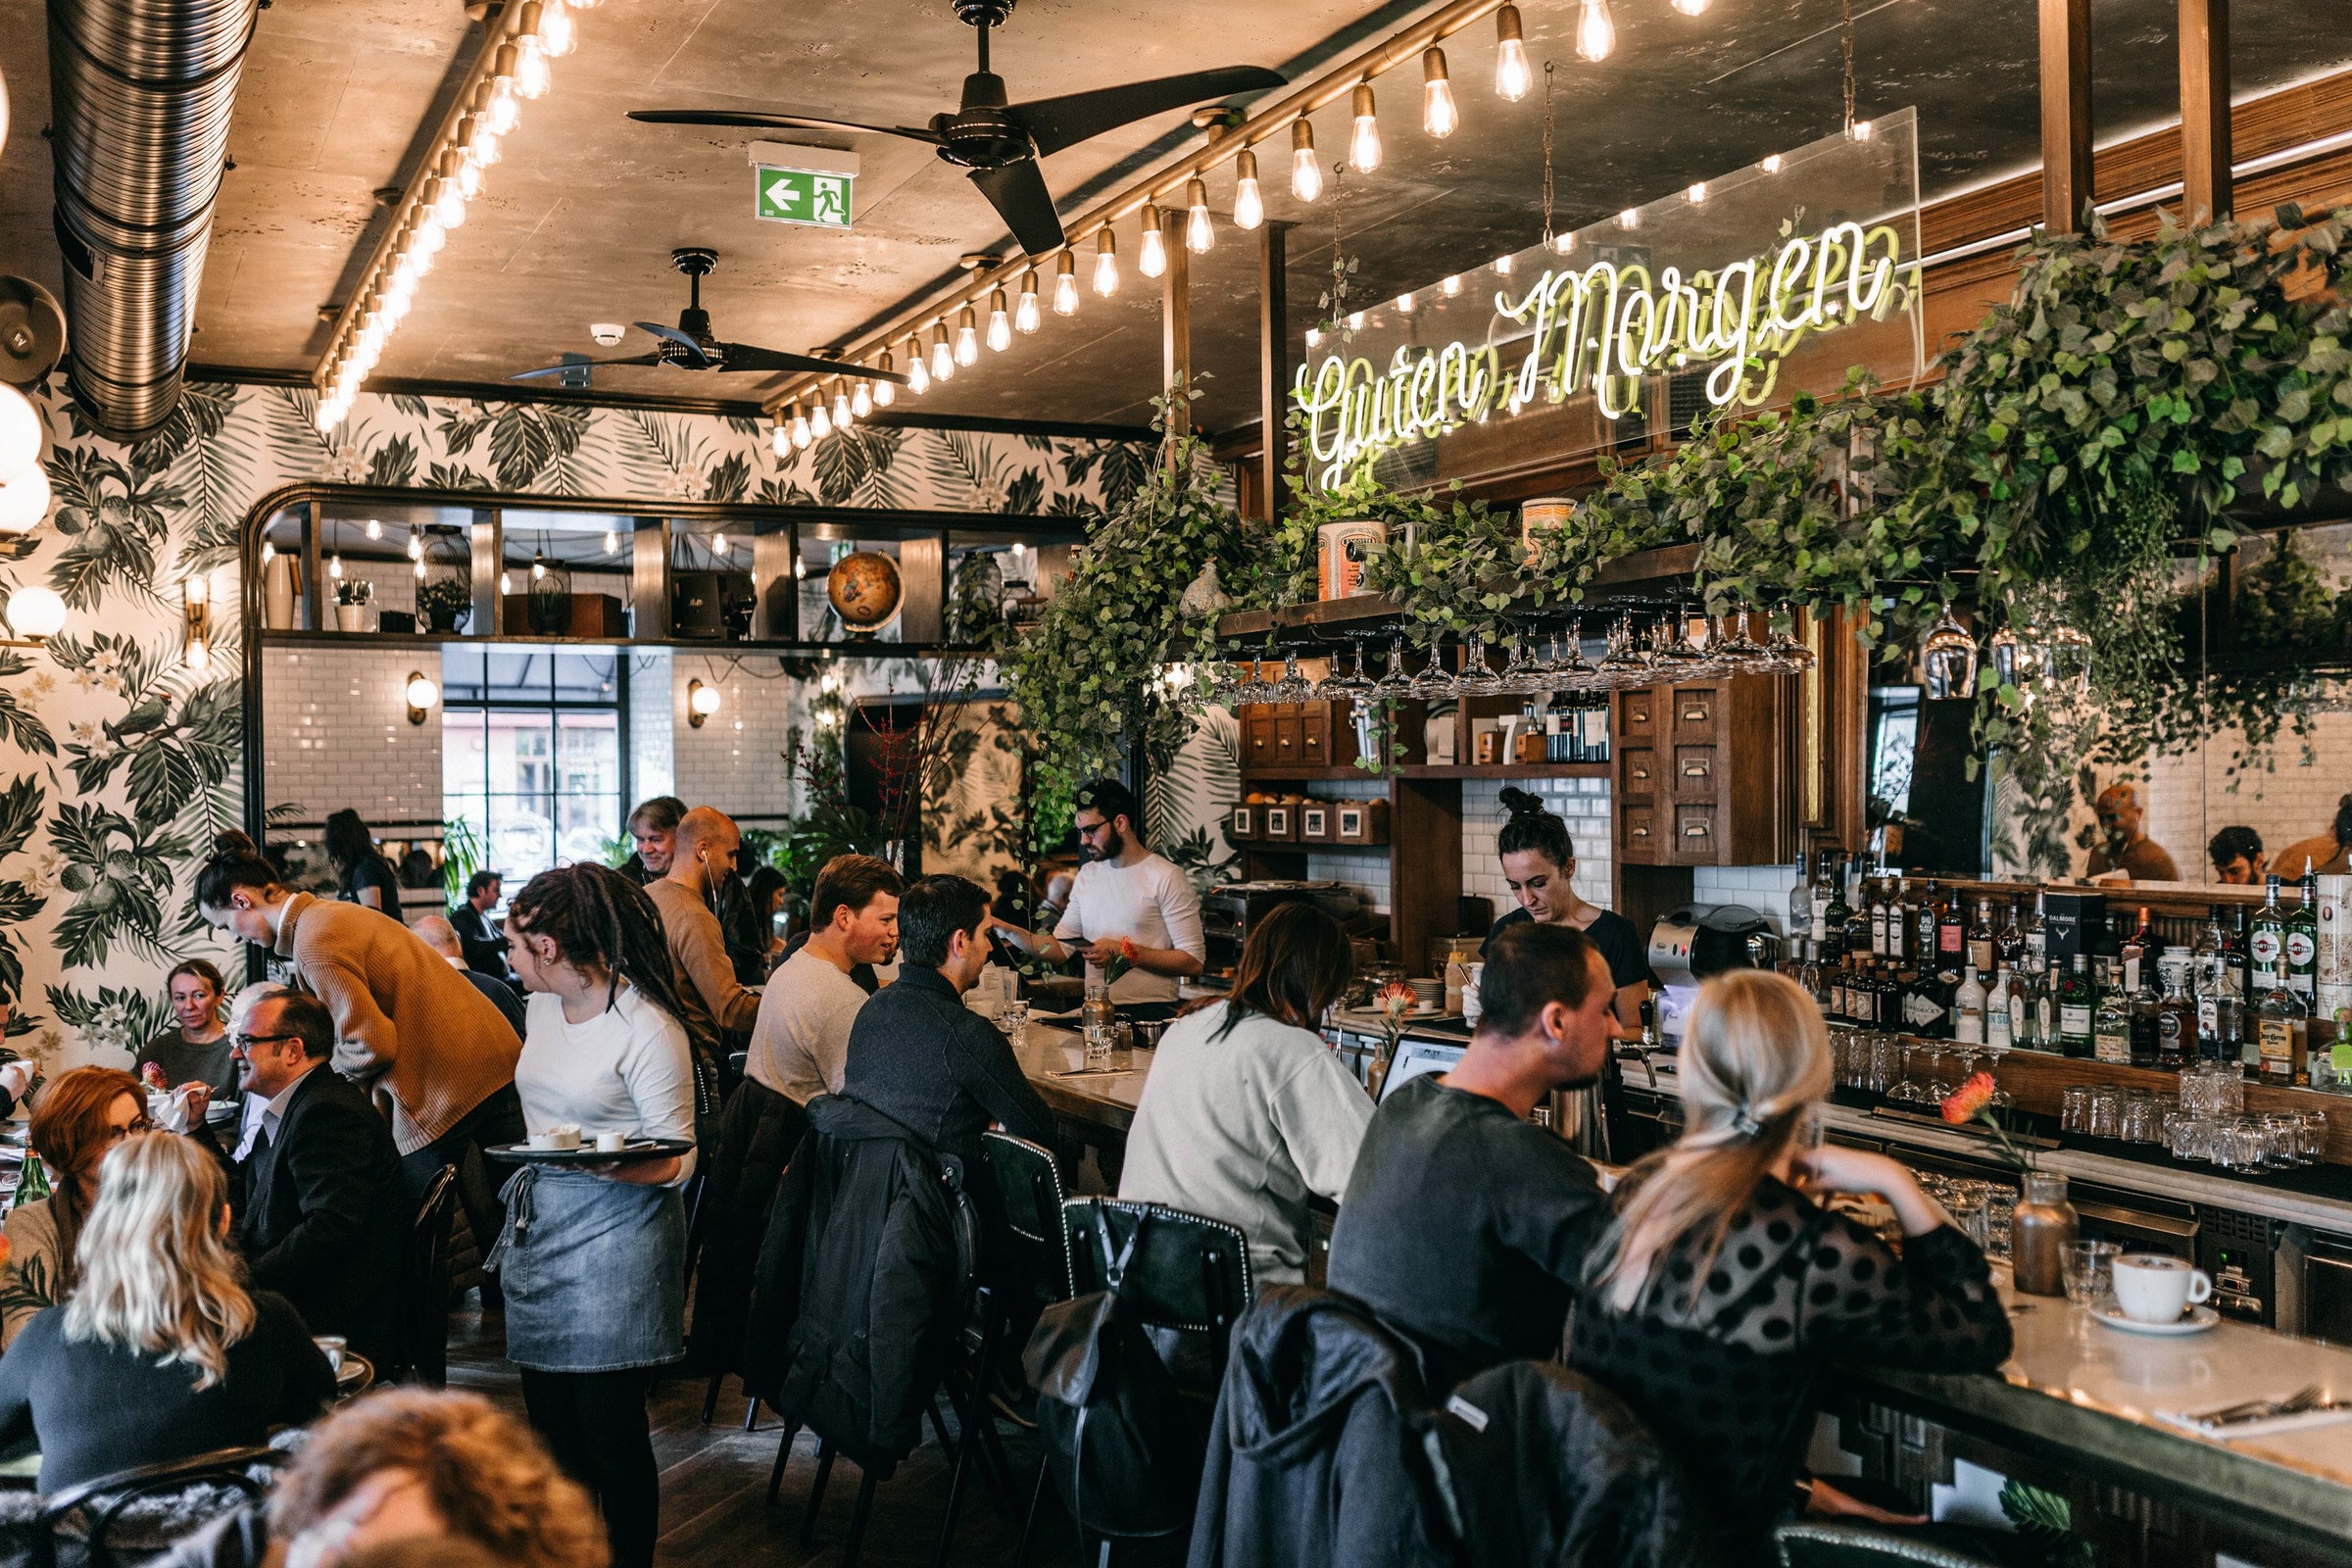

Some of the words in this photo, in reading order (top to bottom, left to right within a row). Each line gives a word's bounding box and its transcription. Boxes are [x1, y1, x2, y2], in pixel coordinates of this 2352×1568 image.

[14, 332, 26, 347] EV
[1297, 341, 1488, 495] Guten
[1494, 220, 1892, 420] Morgen
[1498, 714, 1520, 765] 7
[2048, 914, 2077, 923] DALMORE
[2253, 942, 2277, 951] MARTINI
[2287, 945, 2311, 954] MARTINI
